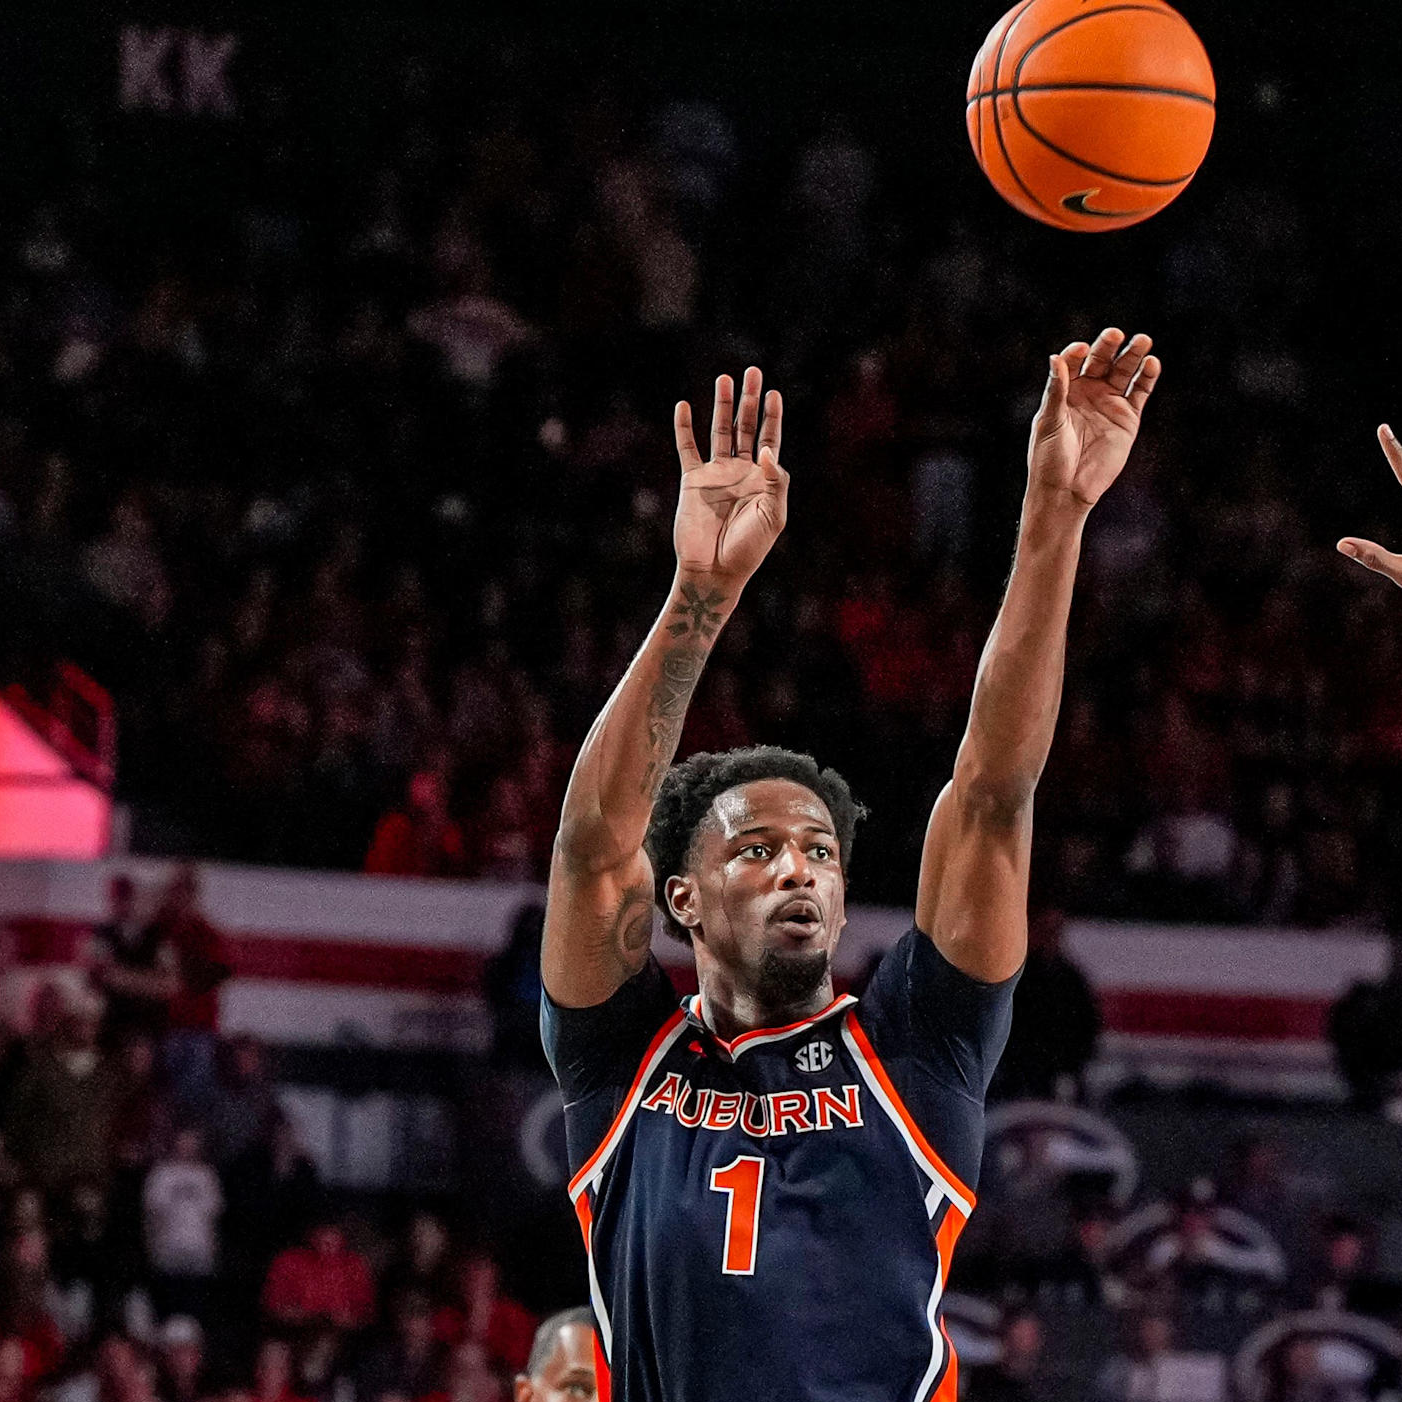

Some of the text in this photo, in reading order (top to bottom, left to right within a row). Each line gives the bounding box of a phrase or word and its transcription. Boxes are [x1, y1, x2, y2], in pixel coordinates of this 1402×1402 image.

[795, 1040, 834, 1072] SEC
[641, 1072, 865, 1139] AUBURN
[709, 1154, 766, 1277] 1
